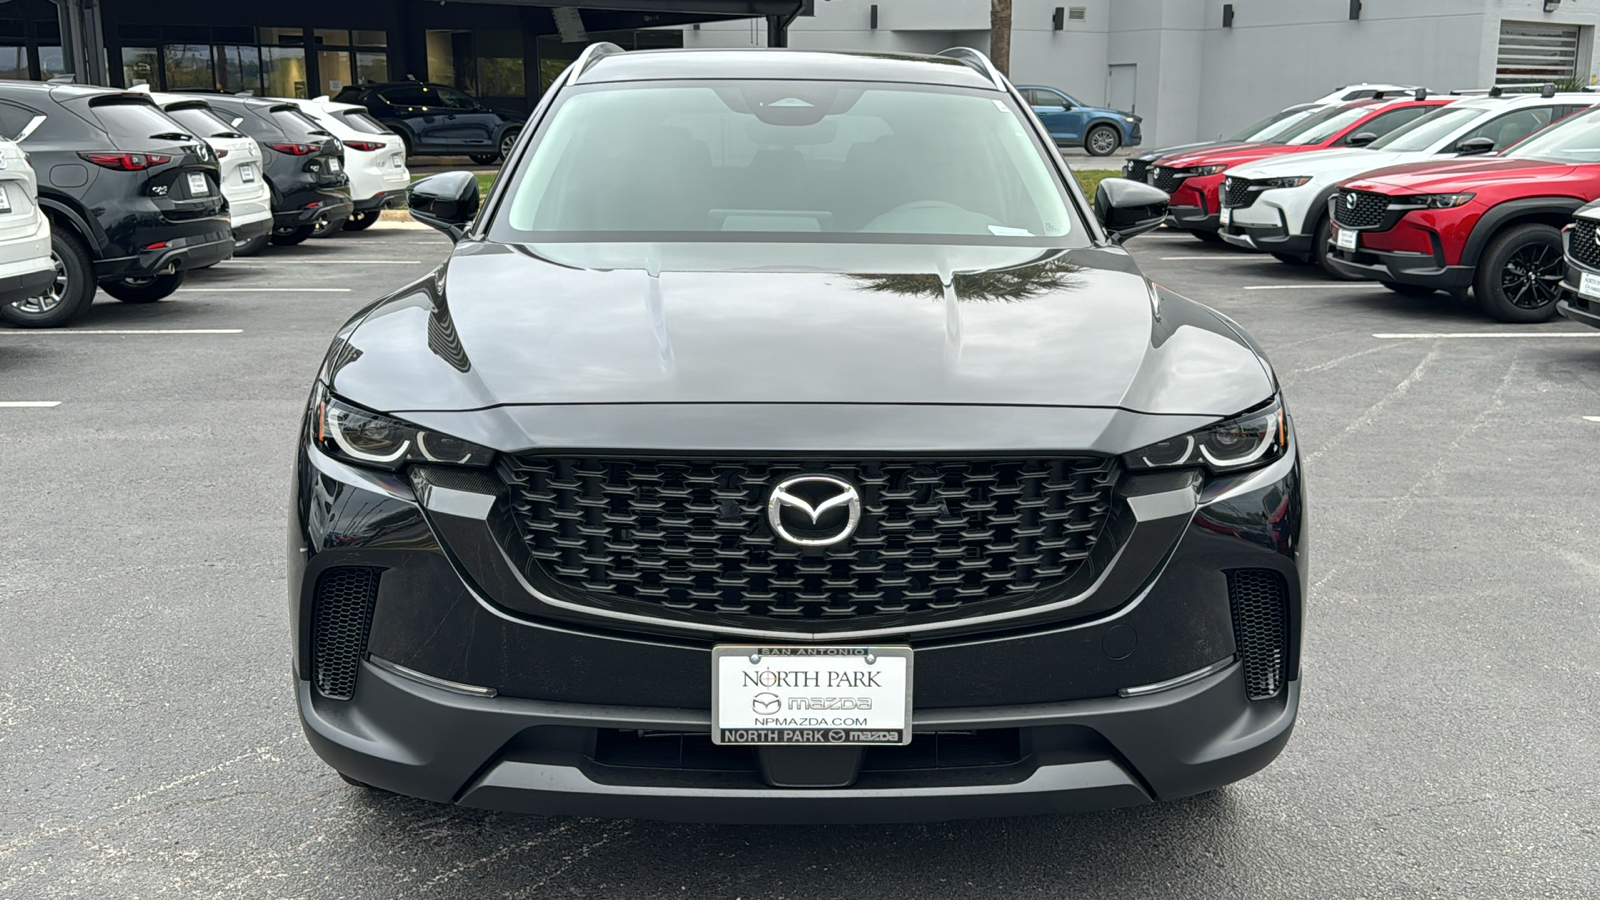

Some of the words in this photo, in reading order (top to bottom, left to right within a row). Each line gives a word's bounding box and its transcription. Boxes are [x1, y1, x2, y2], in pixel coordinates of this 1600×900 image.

[761, 648, 791, 656] SAN
[796, 648, 866, 656] ANTONIO
[742, 670, 819, 688] NORTH
[827, 671, 882, 688] PARK
[754, 717, 868, 727] NPMAZDA.COM
[724, 730, 779, 743] NORTH
[783, 730, 825, 743] PARK
